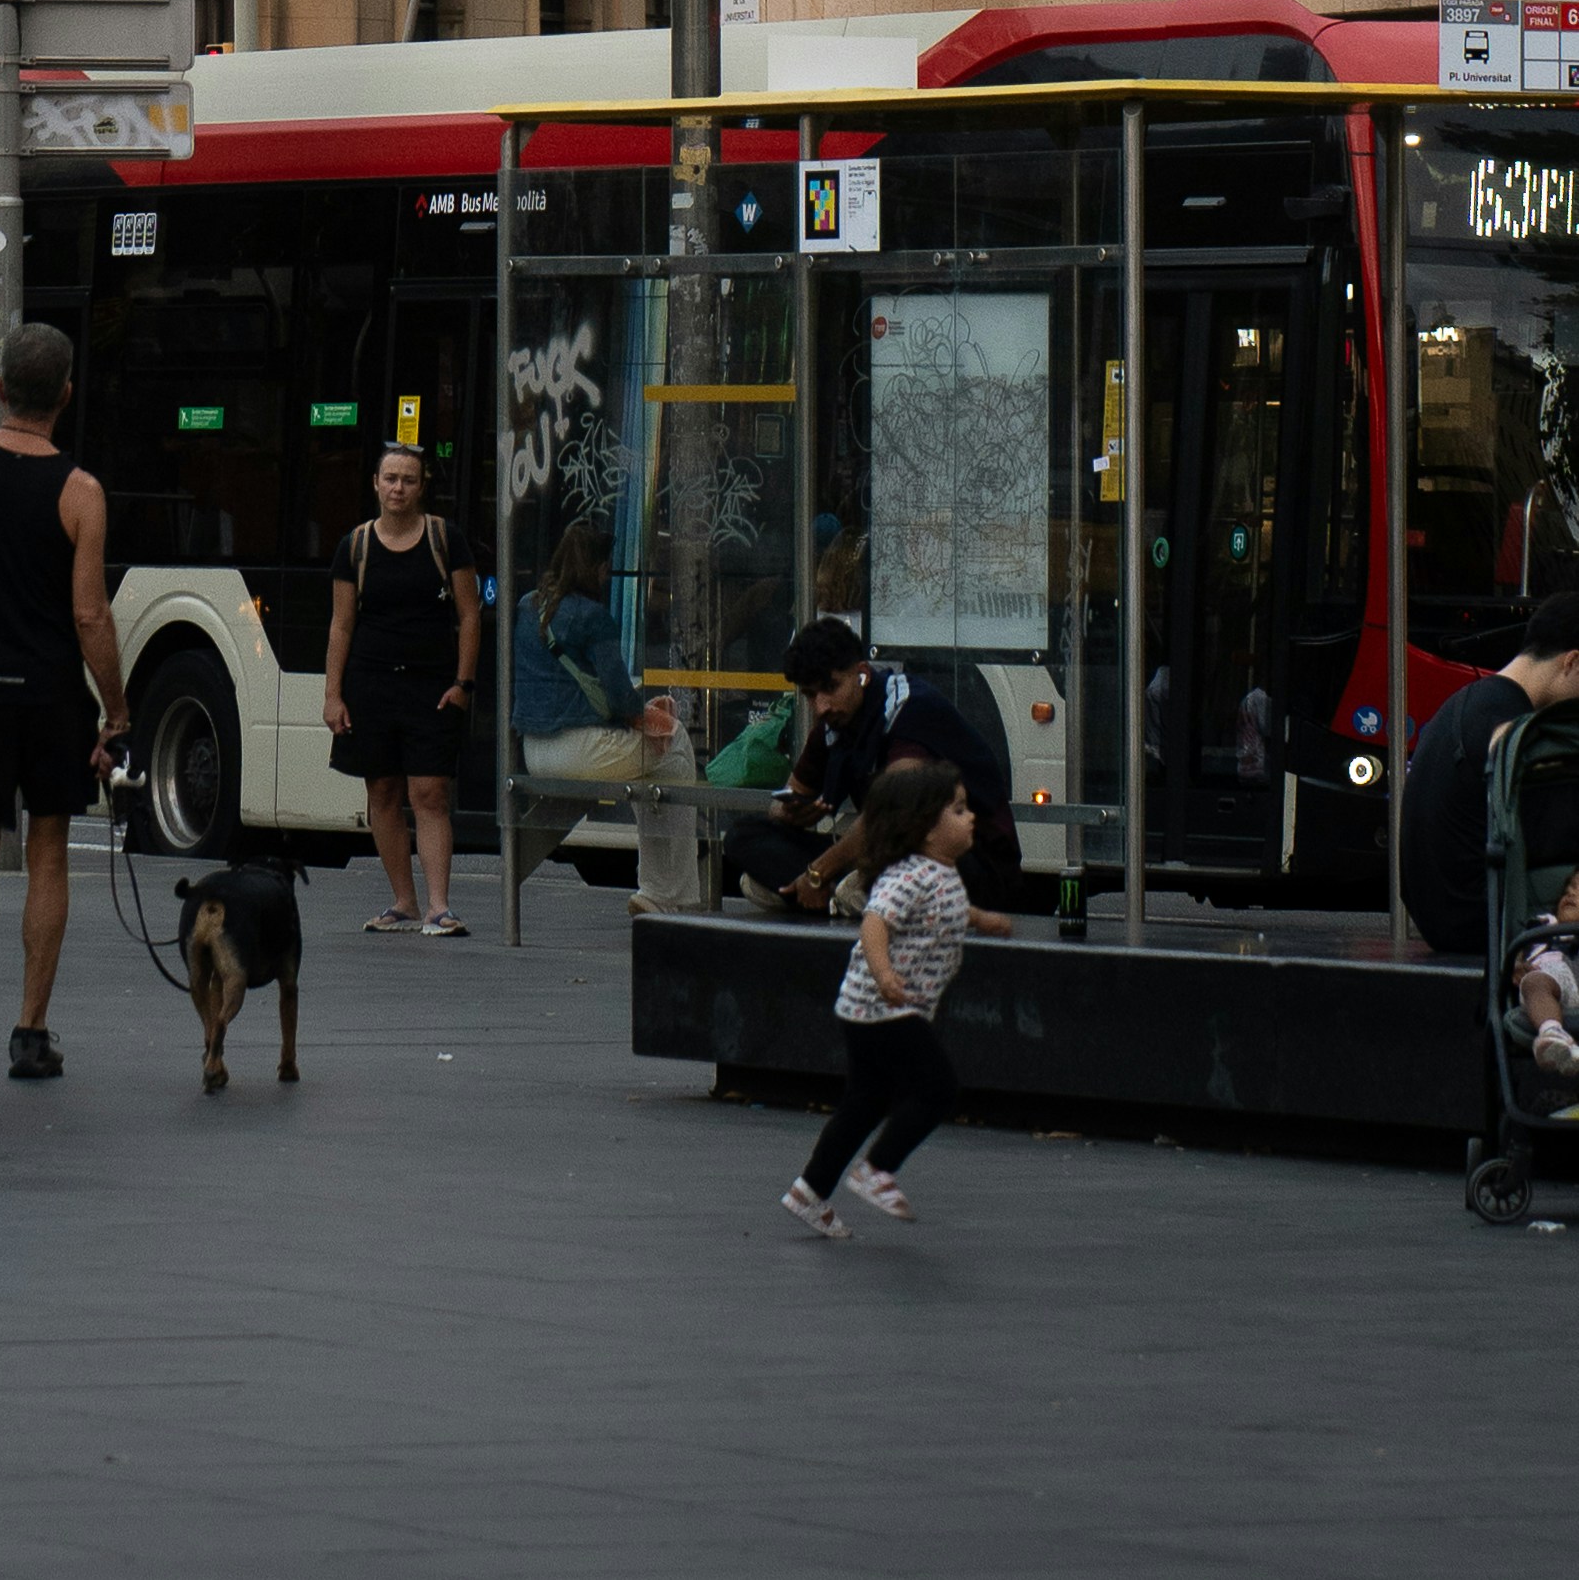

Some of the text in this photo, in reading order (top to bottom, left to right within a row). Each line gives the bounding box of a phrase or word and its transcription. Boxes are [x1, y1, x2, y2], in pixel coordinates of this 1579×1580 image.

[1446, 7, 1480, 22] 3897
[1525, 5, 1579, 25] ORIGEN 6
[1530, 17, 1554, 26] FINAL
[1449, 72, 1512, 82] Pl. Universitat
[429, 193, 455, 214] AMB
[461, 193, 481, 212] Bus
